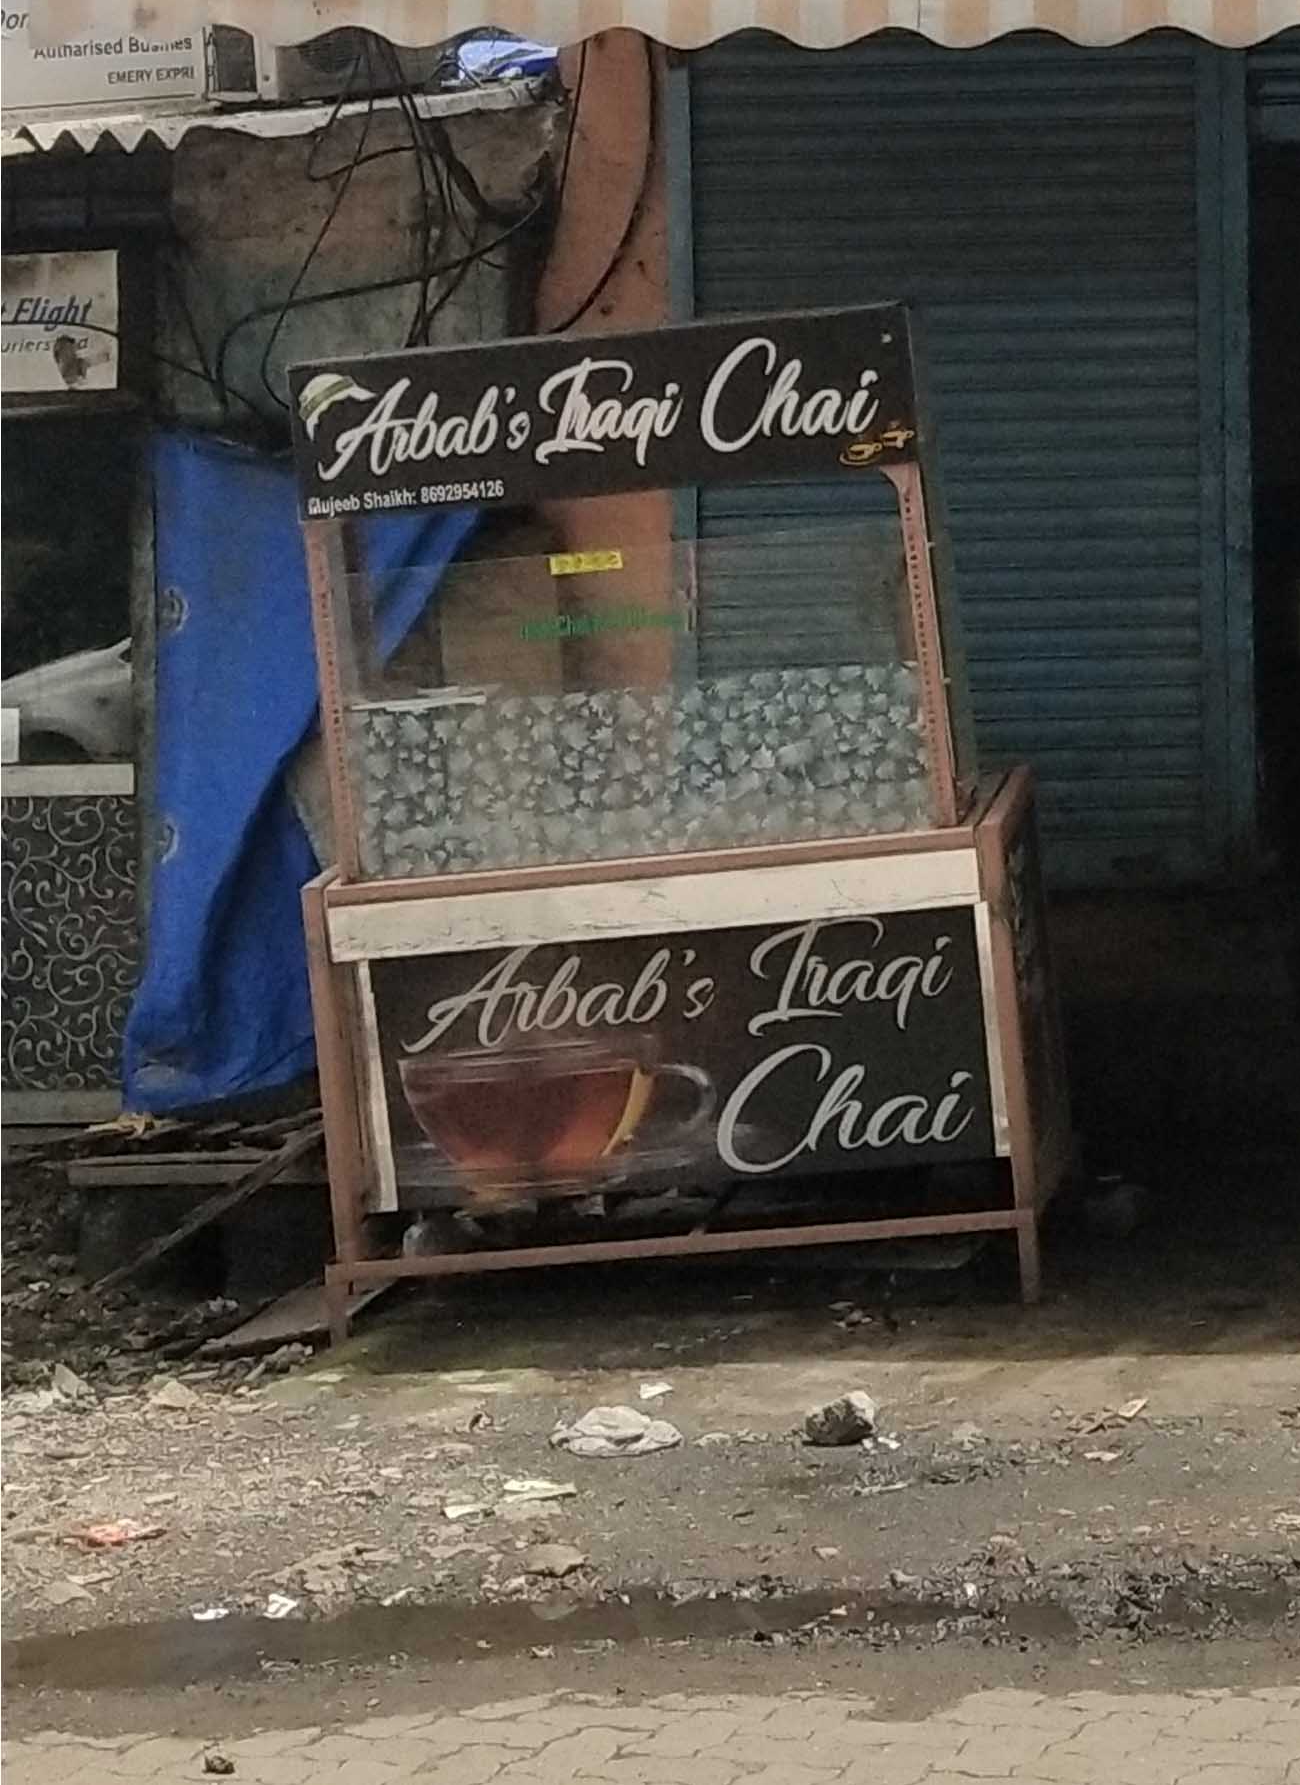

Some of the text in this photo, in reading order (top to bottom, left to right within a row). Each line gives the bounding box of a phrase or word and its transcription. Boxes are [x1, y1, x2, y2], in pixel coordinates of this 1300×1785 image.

[108, 69, 153, 85] EMERY
[14, 295, 93, 332] Flight
[317, 337, 880, 482] Arbab's Iraqi Chai
[363, 488, 417, 509] Shaikh:
[402, 916, 955, 1054] Arbab's Iraqi
[715, 1044, 976, 1174] Chai
